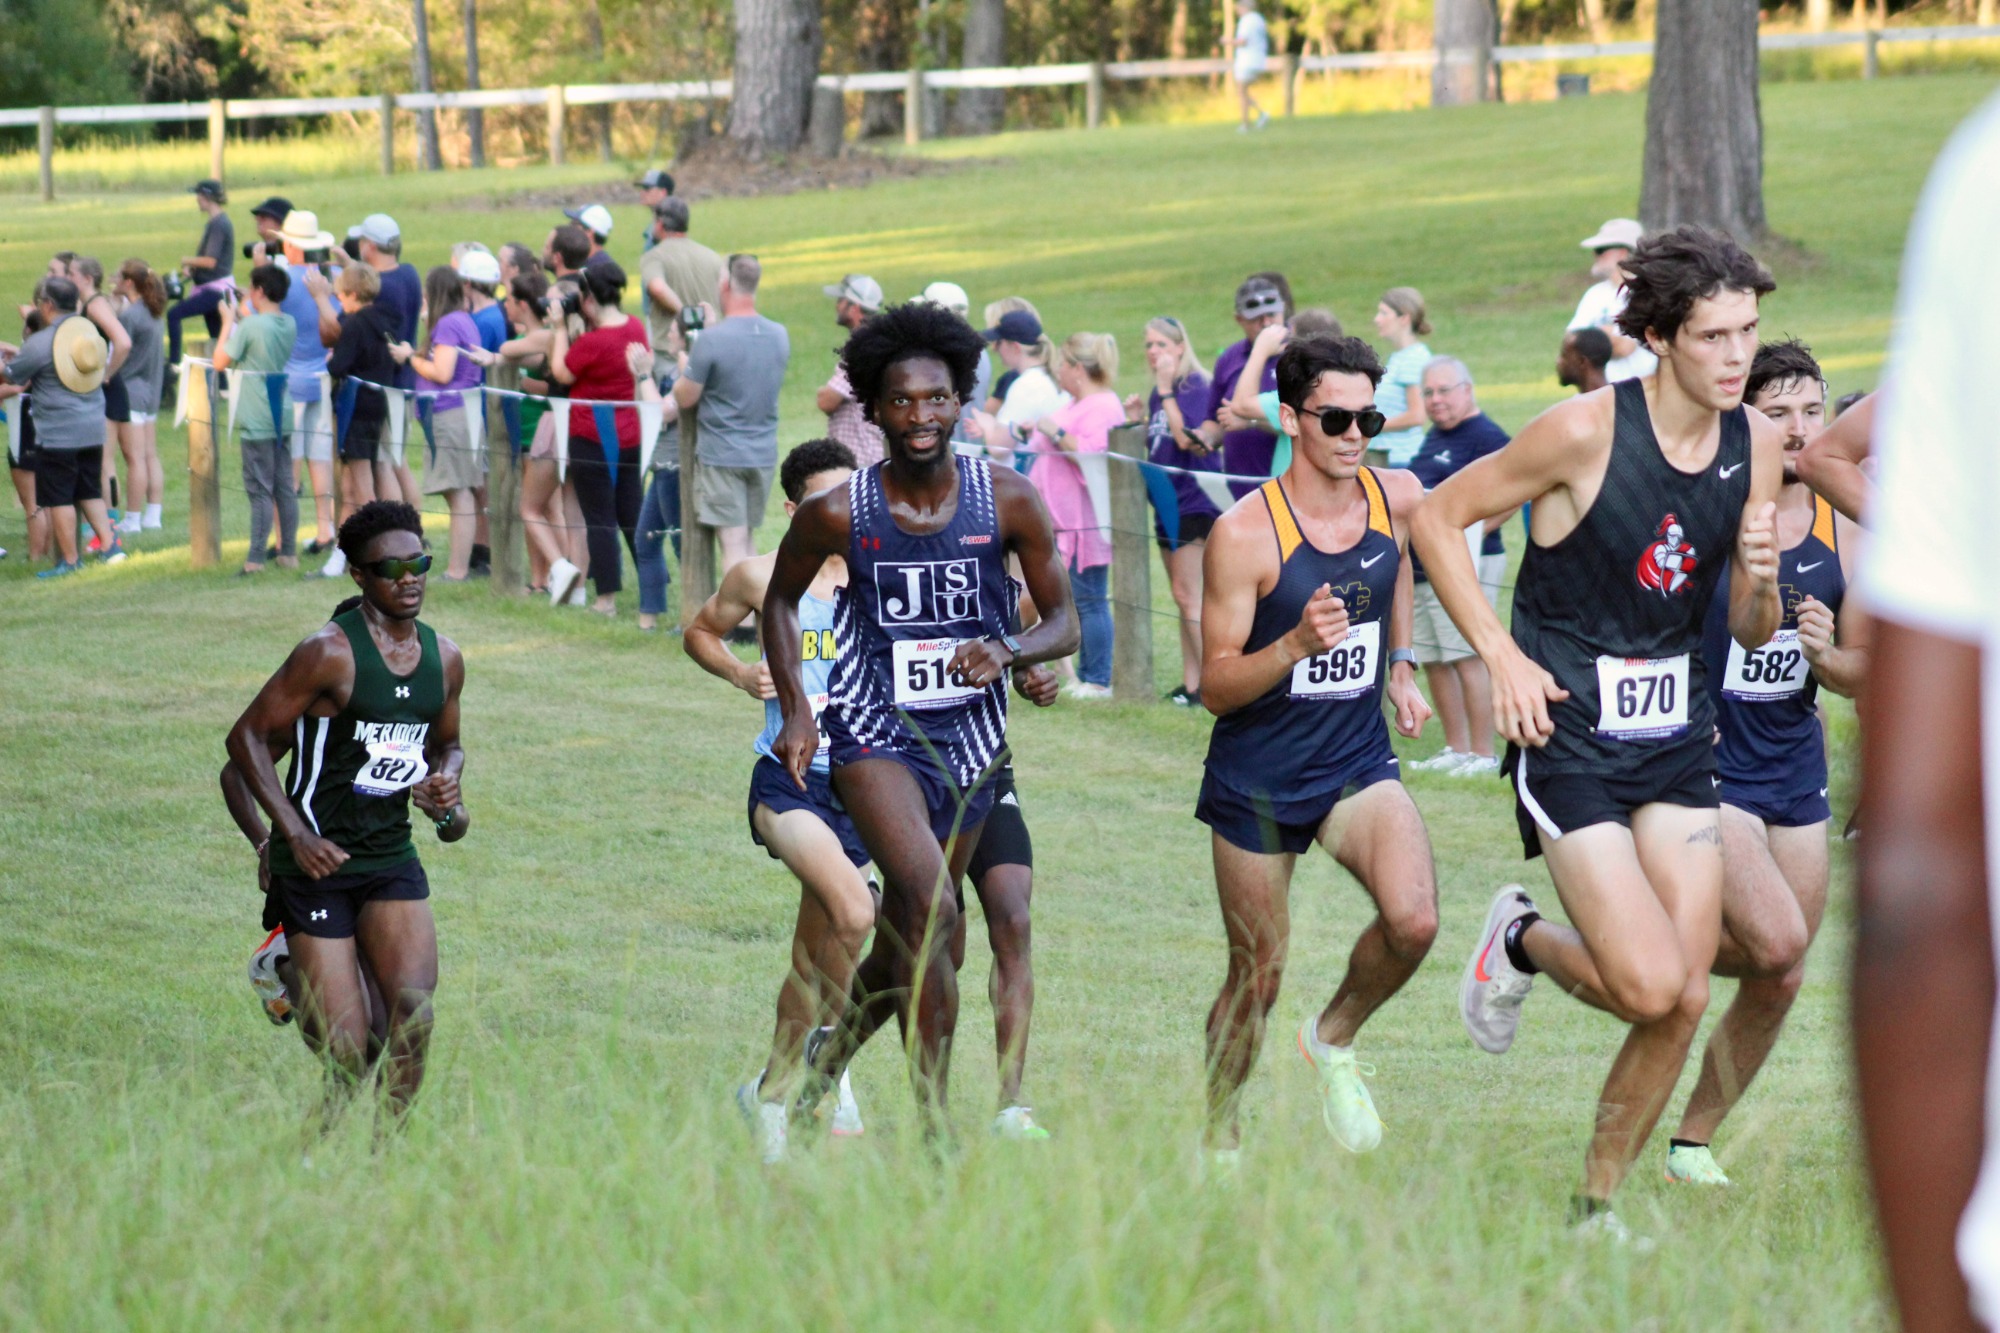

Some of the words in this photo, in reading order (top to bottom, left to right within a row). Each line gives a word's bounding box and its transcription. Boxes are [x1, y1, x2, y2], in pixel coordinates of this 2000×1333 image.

[1308, 645, 1367, 684] 593
[1741, 649, 1801, 684] 582
[1616, 673, 1676, 719] 670
[371, 757, 418, 783] 527
